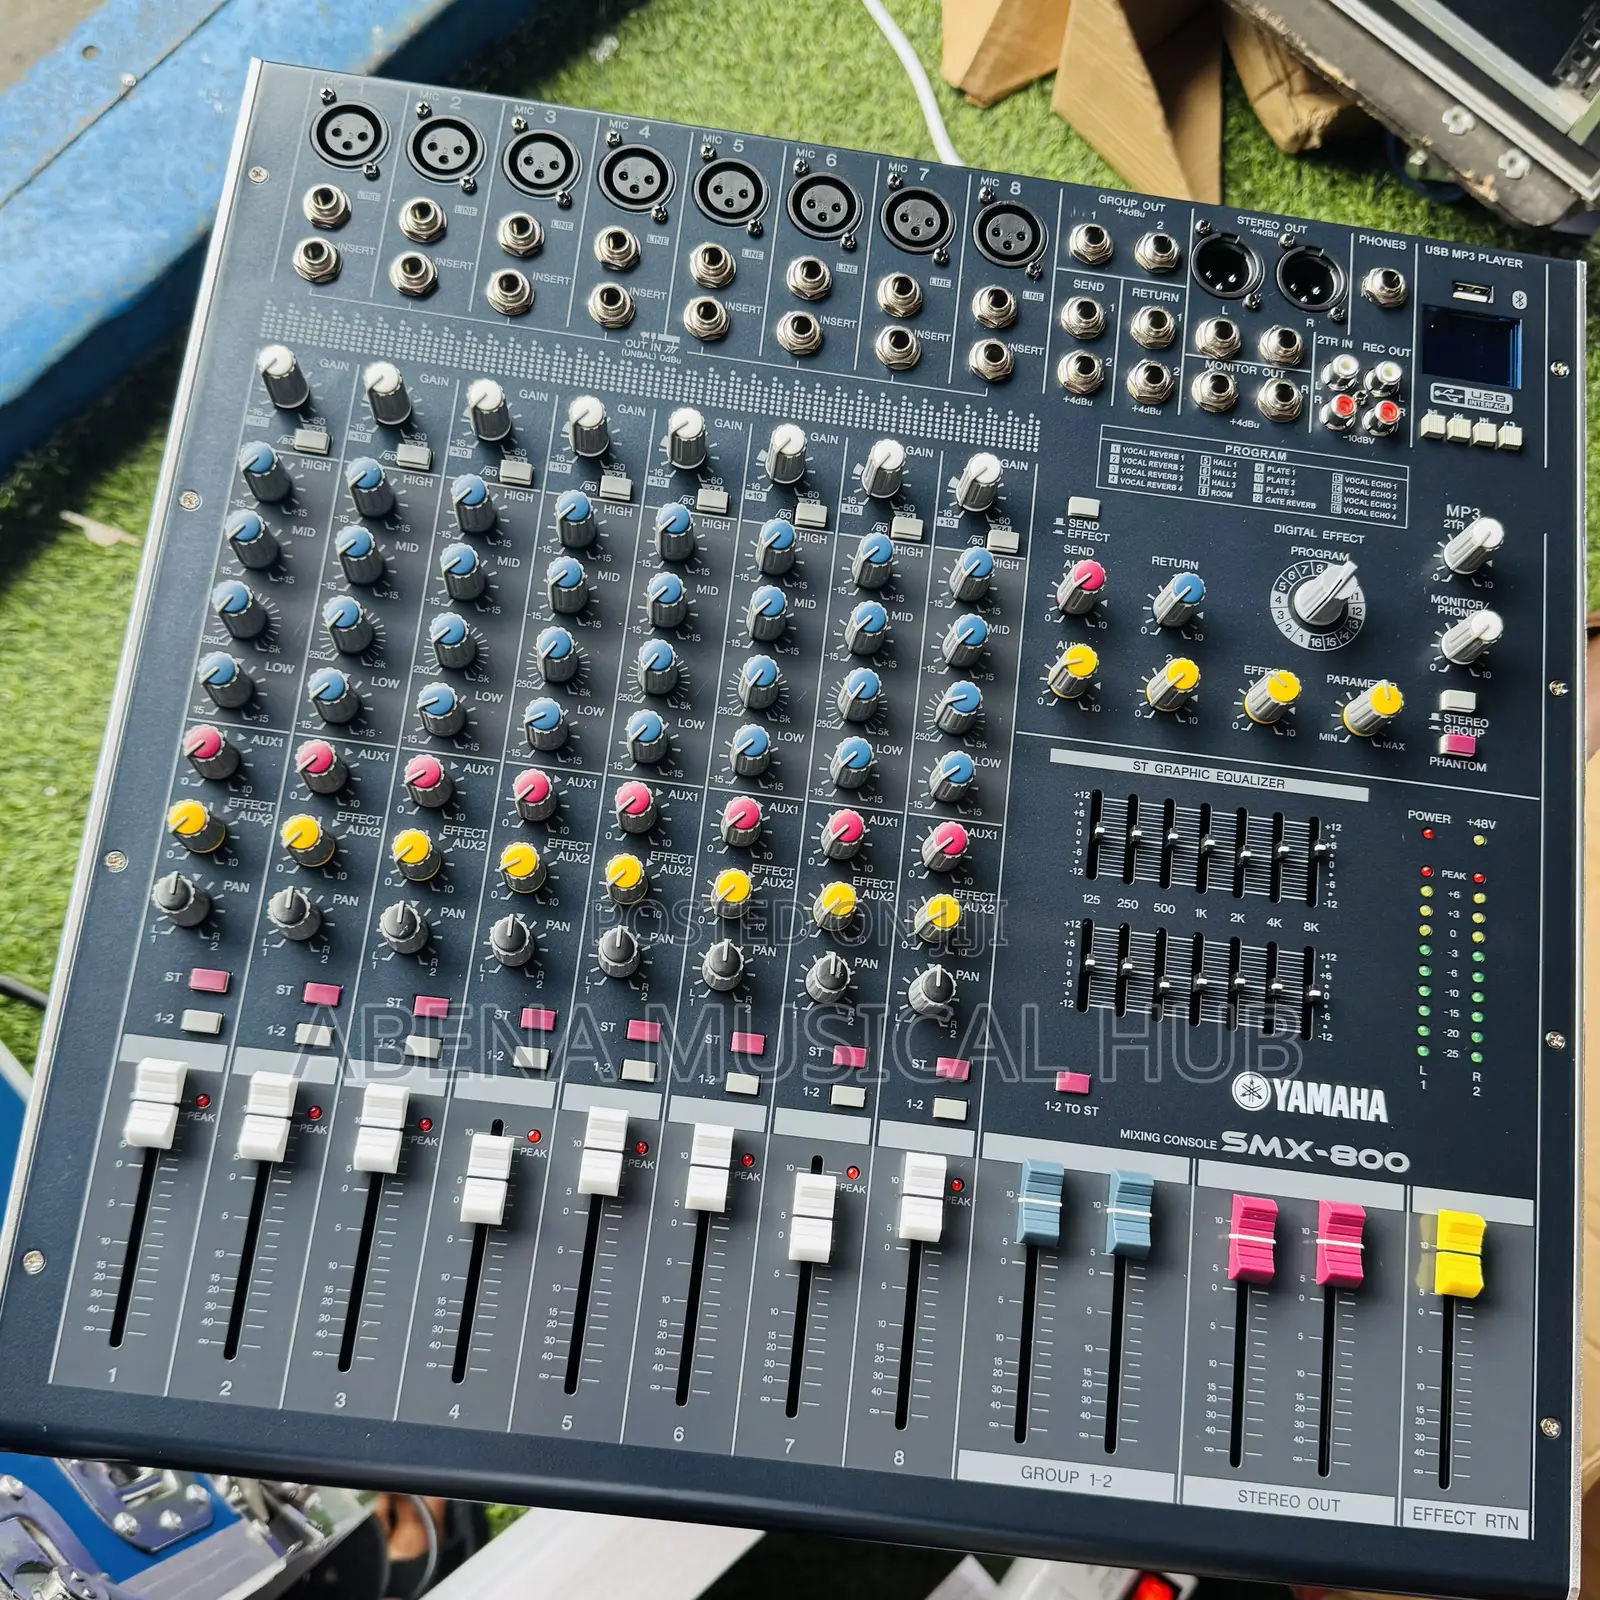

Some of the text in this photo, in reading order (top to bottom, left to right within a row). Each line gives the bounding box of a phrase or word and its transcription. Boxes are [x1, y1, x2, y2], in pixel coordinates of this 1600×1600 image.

[702, 134, 744, 152] MIC 5
[795, 147, 837, 167] MIC 6
[981, 176, 1021, 195] MIC 8
[1099, 195, 1166, 213] GROUP OUT
[1116, 207, 1147, 217] +4dBu
[1237, 216, 1307, 235] STEREO OUT
[1250, 226, 1279, 238] +4dBu
[1359, 235, 1406, 250] PHONES
[1425, 245, 1523, 268] USB MP3 PLAYER
[533, 272, 571, 285] INSERT
[1073, 279, 1104, 291] SEND
[1132, 286, 1181, 302] RETURN
[818, 315, 857, 329] INSERT
[625, 339, 662, 353] OUT IN
[1317, 335, 1353, 348] 2TR IN
[621, 348, 681, 364] (UNBAL) 0dBu
[1363, 342, 1411, 357] REC OUT
[1204, 358, 1286, 380] MONITOR OUT
[420, 374, 449, 386] GAIN
[1063, 396, 1092, 406] +4dBu
[1472, 391, 1506, 402] USB
[1469, 400, 1509, 411] INTERFACE
[811, 432, 838, 444] GAIN
[1122, 447, 1148, 458] VOCAL
[1149, 449, 1180, 460] REVERB
[1225, 445, 1287, 461] PROGRAM
[301, 458, 333, 472] HIGH
[1122, 457, 1147, 466] VOCAL
[1148, 461, 1178, 470] REVERB
[1213, 459, 1231, 467] HALL
[1121, 468, 1146, 476] VOCAL
[1148, 471, 1177, 480] REVERB
[1213, 469, 1231, 477] HALL
[1267, 466, 1295, 475] PLATE 1
[1120, 478, 1145, 487] VOCAL
[1147, 481, 1177, 490] REVERB
[1212, 479, 1230, 487] HALL
[1267, 476, 1289, 485] PLATE
[1345, 477, 1370, 486] VOCAL
[1371, 480, 1392, 489] ECHO
[1211, 490, 1233, 498] ROOM
[1266, 487, 1289, 495] PLATE
[1345, 485, 1369, 496] VOCAL
[1371, 490, 1391, 499] ECHO
[1265, 497, 1316, 509] GATE REVERB
[1344, 497, 1369, 506] VOCAL
[1370, 501, 1391, 509] ECHO
[1344, 507, 1368, 516] VOCAL
[1370, 511, 1391, 519] ECHO
[1446, 504, 1481, 520] MP3
[1068, 519, 1099, 531] SEND
[1443, 519, 1465, 530] 2TR
[799, 531, 828, 544] HIGH
[1068, 529, 1110, 542] EFFECT
[1274, 524, 1365, 544] DIGITAL EFFECT
[1064, 544, 1094, 556] SEND
[1290, 546, 1350, 562] PROGRAM
[1152, 556, 1198, 570] RETURN
[697, 585, 718, 595] MID
[892, 611, 913, 622] MID
[265, 662, 295, 674] LOW
[1444, 714, 1489, 728] STEREO
[1444, 724, 1485, 737] GROUP
[1319, 733, 1337, 742] MIN
[877, 744, 903, 755] LOW
[1383, 742, 1404, 750] MAX
[1430, 756, 1486, 772] PHANTOM
[1133, 761, 1285, 790] ST GRAPHIC EQUALIZER
[668, 790, 698, 802] AUX1
[769, 803, 798, 814] AUX1
[336, 812, 383, 824] EFFECT
[1408, 810, 1451, 824] POWER
[1467, 819, 1496, 829] +48V
[346, 824, 381, 838] AUX2
[650, 851, 694, 864] EFFECT
[660, 863, 692, 876] AUX2
[1442, 870, 1466, 880] PEAK
[223, 881, 250, 893] PAN
[852, 876, 896, 890] EFFECT
[861, 889, 894, 901] AUX2
[1083, 894, 1319, 932] 125 250 500 1K 2K 4K 8K
[546, 920, 570, 932] PAN
[164, 972, 183, 982] ST
[955, 970, 979, 982] PAN
[155, 1013, 174, 1023] 1-2
[907, 1099, 923, 1109] 1-2
[1273, 1078, 1388, 1123] YAMAHA
[1045, 1101, 1099, 1116] 1-2 TO ST
[301, 1123, 329, 1136] PEAK
[520, 1147, 547, 1158] PEAK
[1121, 1129, 1410, 1173] MIXING CONSOLE SMX-800
[840, 1182, 866, 1194] PEAK
[109, 1368, 116, 1382] 1
[219, 1381, 232, 1395] 2
[449, 1404, 459, 1419] 4
[674, 1427, 684, 1442] 6
[894, 1451, 904, 1465] 8
[1021, 1467, 1112, 1489] GROUP 1-2
[1237, 1489, 1341, 1513] STEREO OUT
[1413, 1507, 1519, 1530] EFFECT RTN
